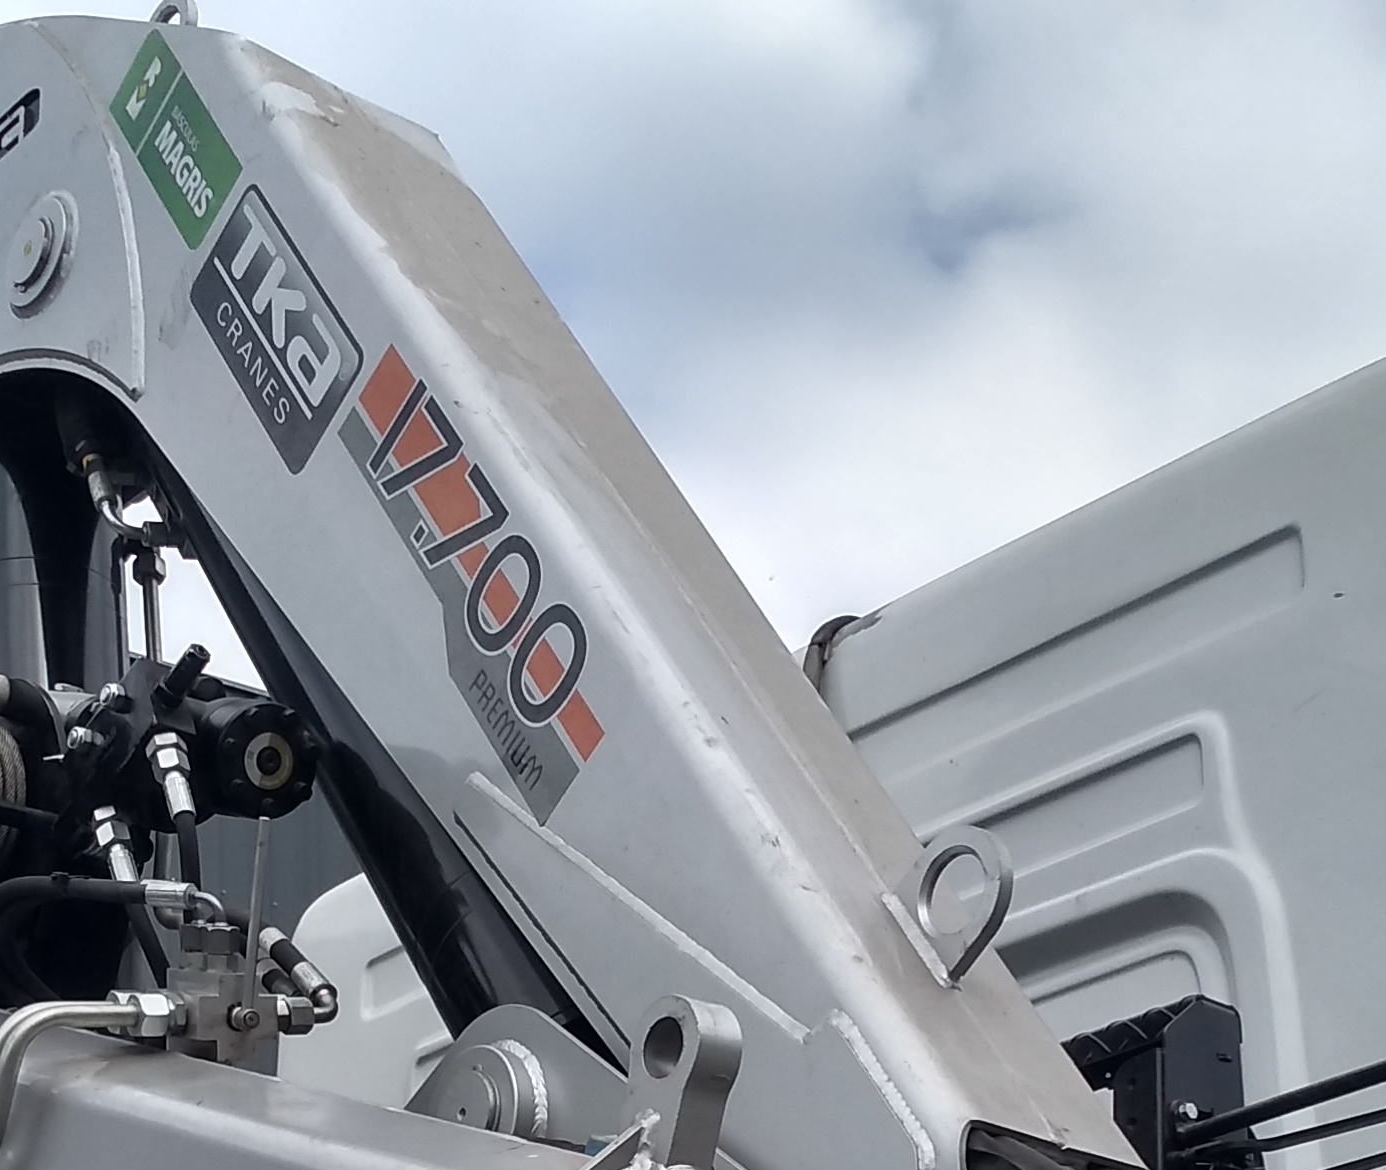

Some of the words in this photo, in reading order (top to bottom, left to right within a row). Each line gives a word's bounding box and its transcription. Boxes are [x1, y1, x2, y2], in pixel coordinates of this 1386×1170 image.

[154, 120, 213, 218] MAGRIS
[216, 302, 291, 424] CRANES
[366, 377, 588, 728] 17.700
[468, 669, 544, 790] PREMIUM
